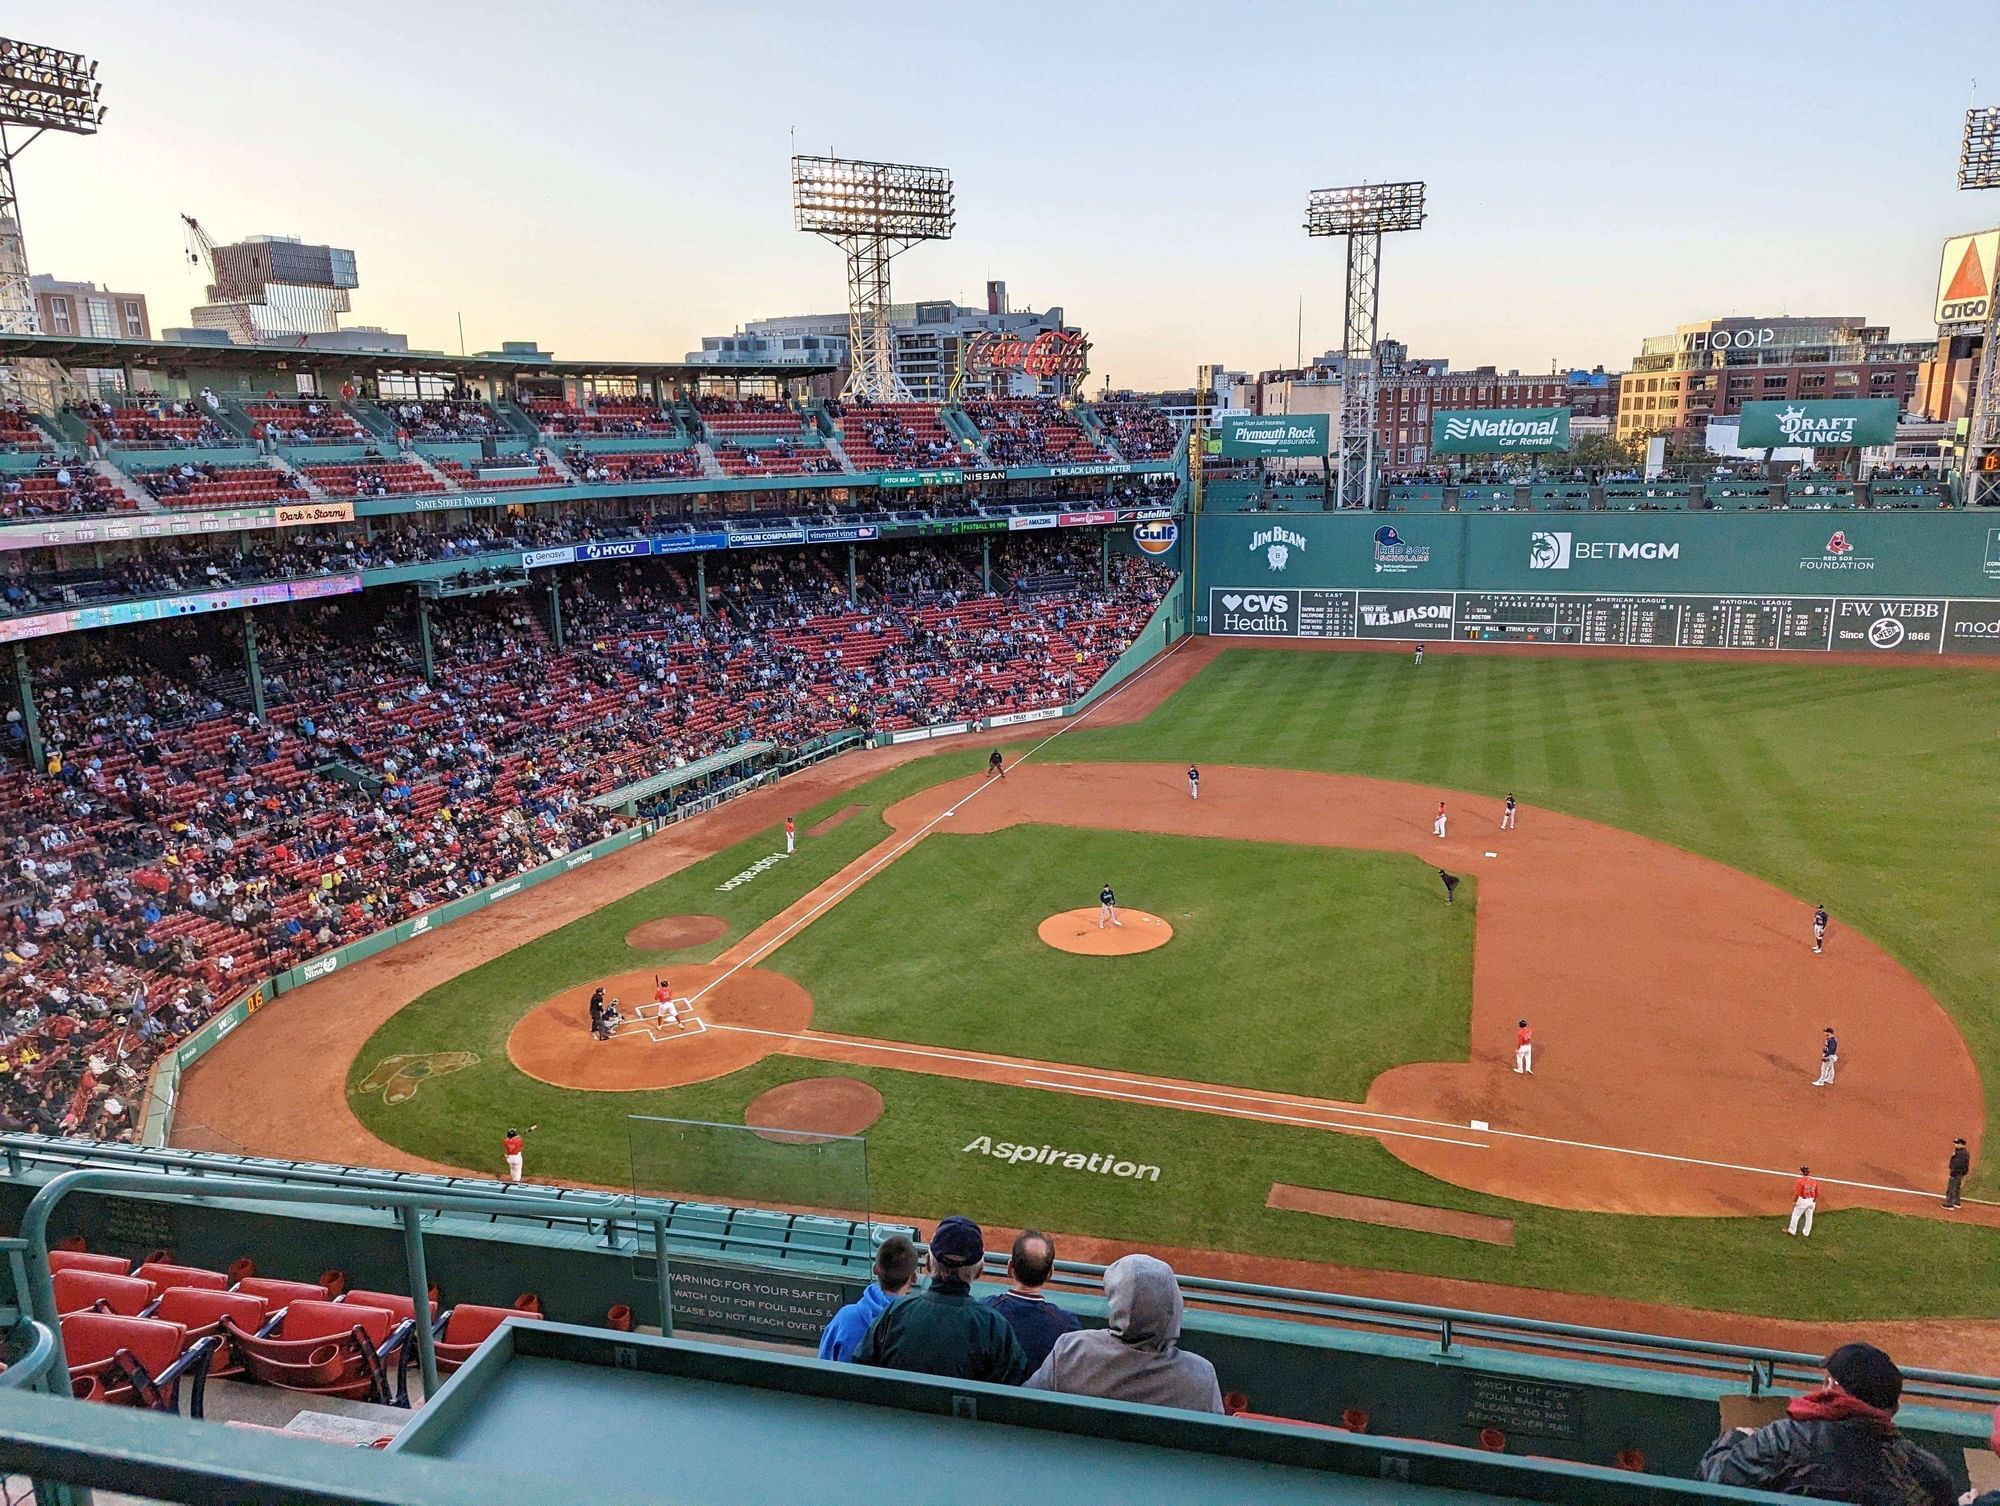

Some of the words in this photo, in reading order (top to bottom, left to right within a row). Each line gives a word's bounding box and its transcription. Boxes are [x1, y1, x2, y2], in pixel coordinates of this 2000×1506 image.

[1941, 301, 1987, 320] CITGO
[1672, 328, 1774, 350] WHOOP
[1780, 416, 1858, 435] DRAFT
[1235, 427, 1285, 440] Plymouth
[1288, 426, 1316, 438] Rock
[1788, 430, 1853, 444] KINGS
[1499, 438, 1516, 446] Car
[1519, 437, 1552, 445] Rental
[1106, 465, 1131, 473] MATTER
[964, 472, 1005, 481] NISSAN
[416, 500, 437, 510] STATE
[437, 499, 462, 508] STREET
[464, 496, 496, 506] PAVILION
[280, 512, 304, 521] Dark
[314, 508, 346, 520] Stormy
[1136, 510, 1170, 520] Safelite
[730, 534, 761, 542] COGHLIN
[762, 532, 803, 540] COMPANIES
[810, 530, 838, 540] vineyard
[1135, 525, 1176, 540] Gulf
[1249, 530, 1272, 552] JIM
[1273, 526, 1307, 552] BEAM
[536, 552, 566, 561] Genasys
[602, 544, 634, 555] HYCU
[1380, 546, 1404, 554] RED
[1406, 546, 1430, 554] SOX
[1575, 543, 1680, 560] BETMGM
[1800, 562, 1874, 570] FOUNDATION
[1243, 595, 1288, 613] CVS
[1880, 603, 1939, 618] WEBB
[1223, 614, 1288, 632] Health
[1840, 631, 1864, 640] Since
[1907, 632, 1931, 641] 1866
[961, 1135, 1161, 1182] Aspiration
[724, 1280, 751, 1291] FOR
[753, 1284, 789, 1296] YOUR
[792, 1289, 840, 1302] SAFETY
[674, 1290, 707, 1301] WATCH
[710, 1294, 730, 1304] OUT
[734, 1298, 756, 1308] FOR
[758, 1301, 786, 1312] FOUL
[789, 1305, 823, 1316] BALLS
[708, 1310, 723, 1319] DO
[726, 1312, 746, 1321] NOT
[749, 1315, 784, 1327] REACH
[787, 1320, 818, 1332] OVER
[1474, 1380, 1512, 1392] WATCH
[1546, 1389, 1570, 1399] FOR
[1479, 1391, 1510, 1402] FOUL
[1514, 1396, 1552, 1409] BALLS
[1474, 1401, 1520, 1415] PLEASE
